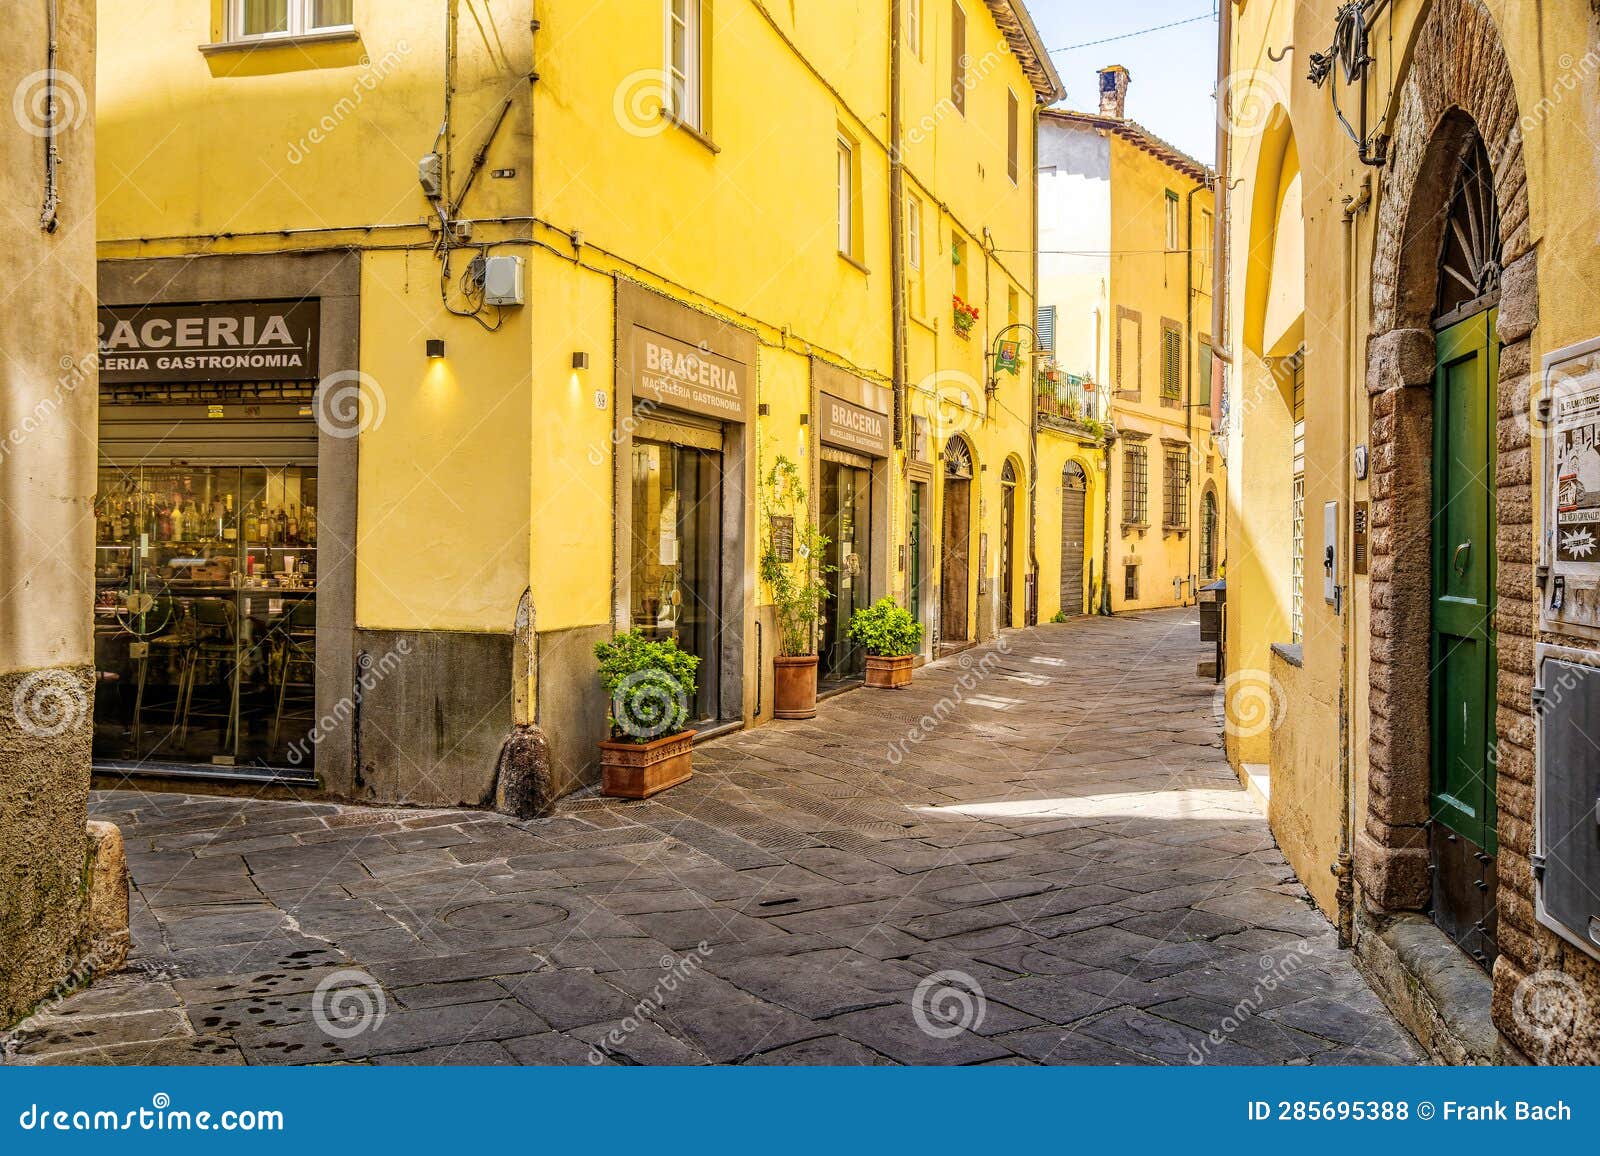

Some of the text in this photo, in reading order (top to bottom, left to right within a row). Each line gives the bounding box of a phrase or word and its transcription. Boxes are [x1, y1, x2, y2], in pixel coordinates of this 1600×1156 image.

[156, 354, 303, 370] GASTRONOMIA
[646, 342, 738, 395] BRACERIA
[692, 390, 741, 413] GASTRONOMIA
[831, 404, 882, 437] BRACERIA
